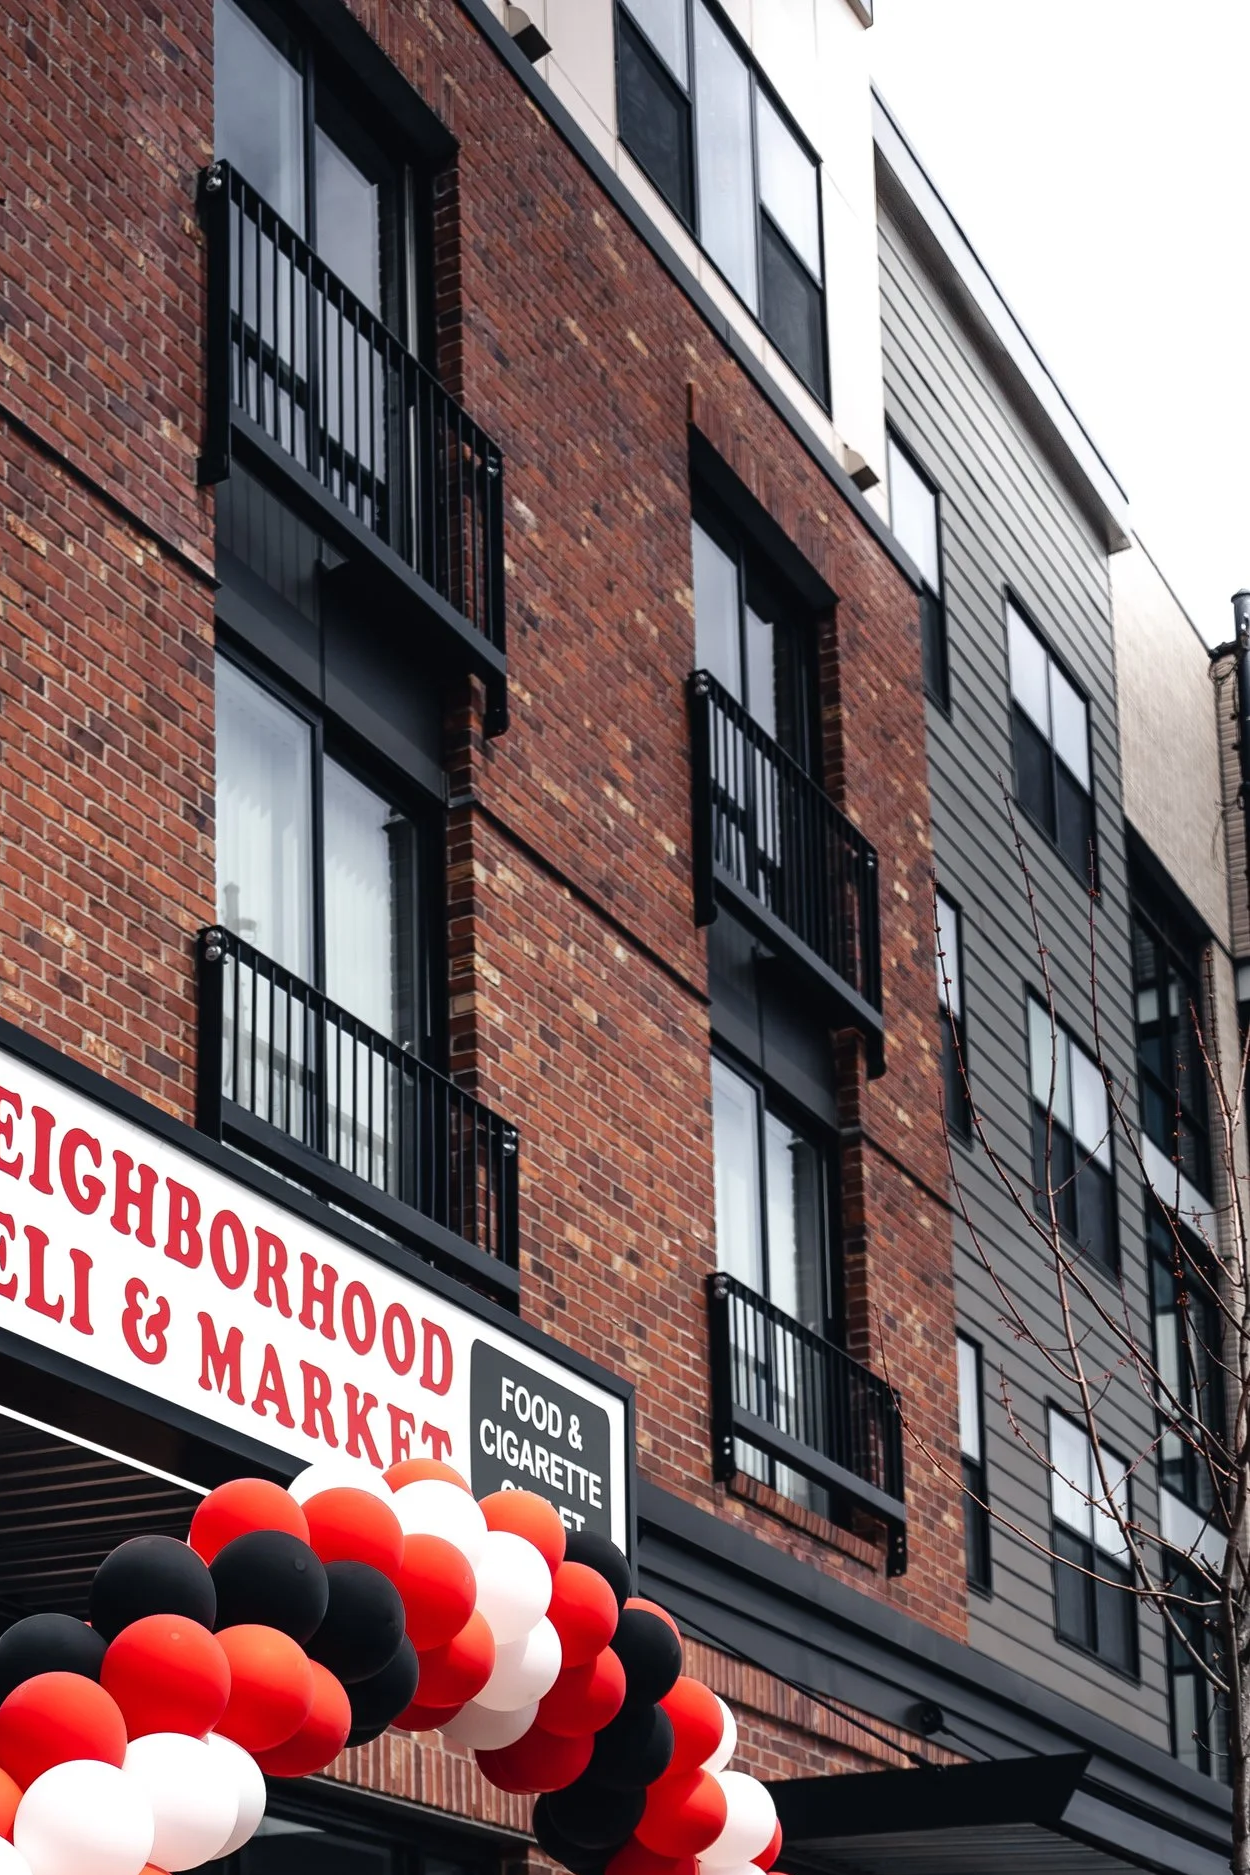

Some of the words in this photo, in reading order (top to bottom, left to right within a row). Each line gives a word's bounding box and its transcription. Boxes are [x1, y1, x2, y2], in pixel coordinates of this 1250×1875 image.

[122, 1277, 170, 1366] &
[500, 1376, 563, 1439] FOOD
[567, 1414, 583, 1452] &
[479, 1418, 602, 1510] CIGARETTE
